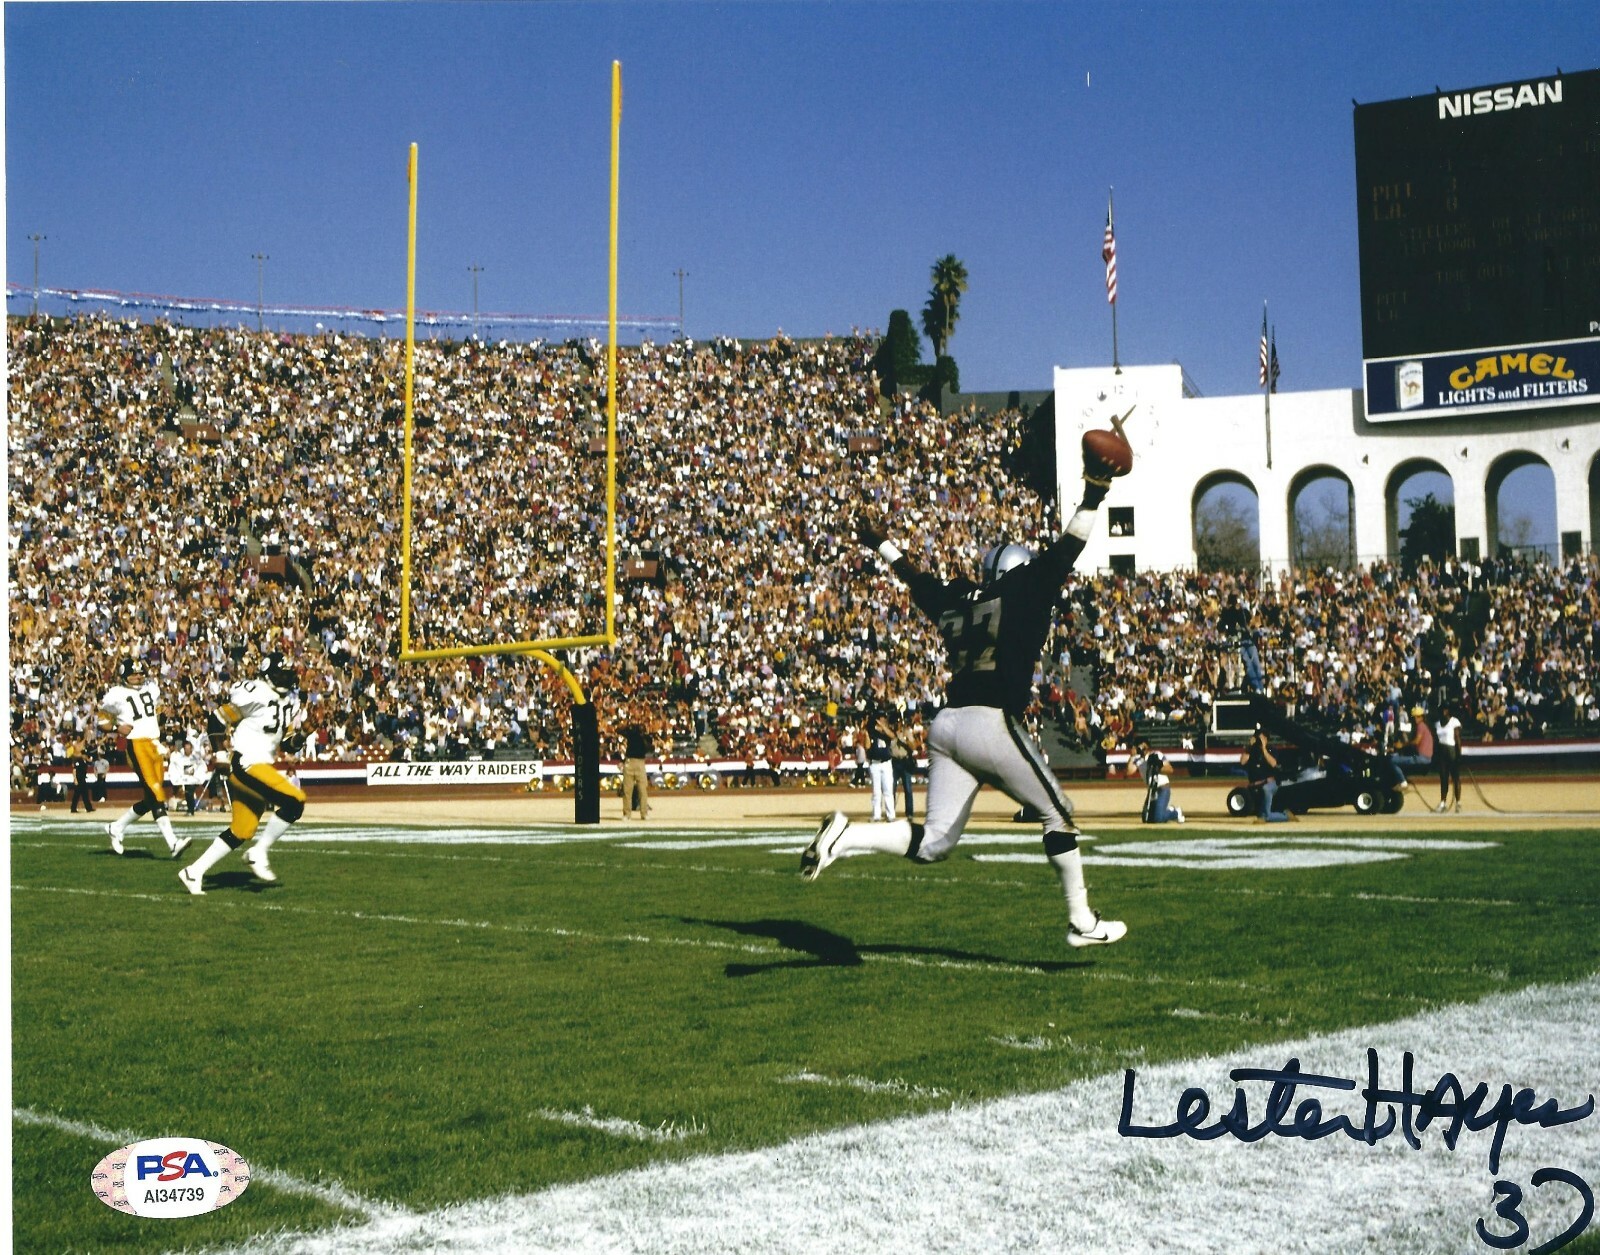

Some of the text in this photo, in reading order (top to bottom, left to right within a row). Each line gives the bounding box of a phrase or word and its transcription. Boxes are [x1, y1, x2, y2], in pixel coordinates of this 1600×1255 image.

[1438, 80, 1562, 120] NISSAN
[1449, 353, 1575, 390] CAMEL
[1439, 387, 1496, 406] LIGHTS
[1498, 386, 1520, 400] and
[1522, 378, 1588, 398] FILTERS
[126, 691, 155, 721] 18
[263, 700, 293, 735] 30
[371, 763, 537, 778] ALL THE WAY RAIDERS
